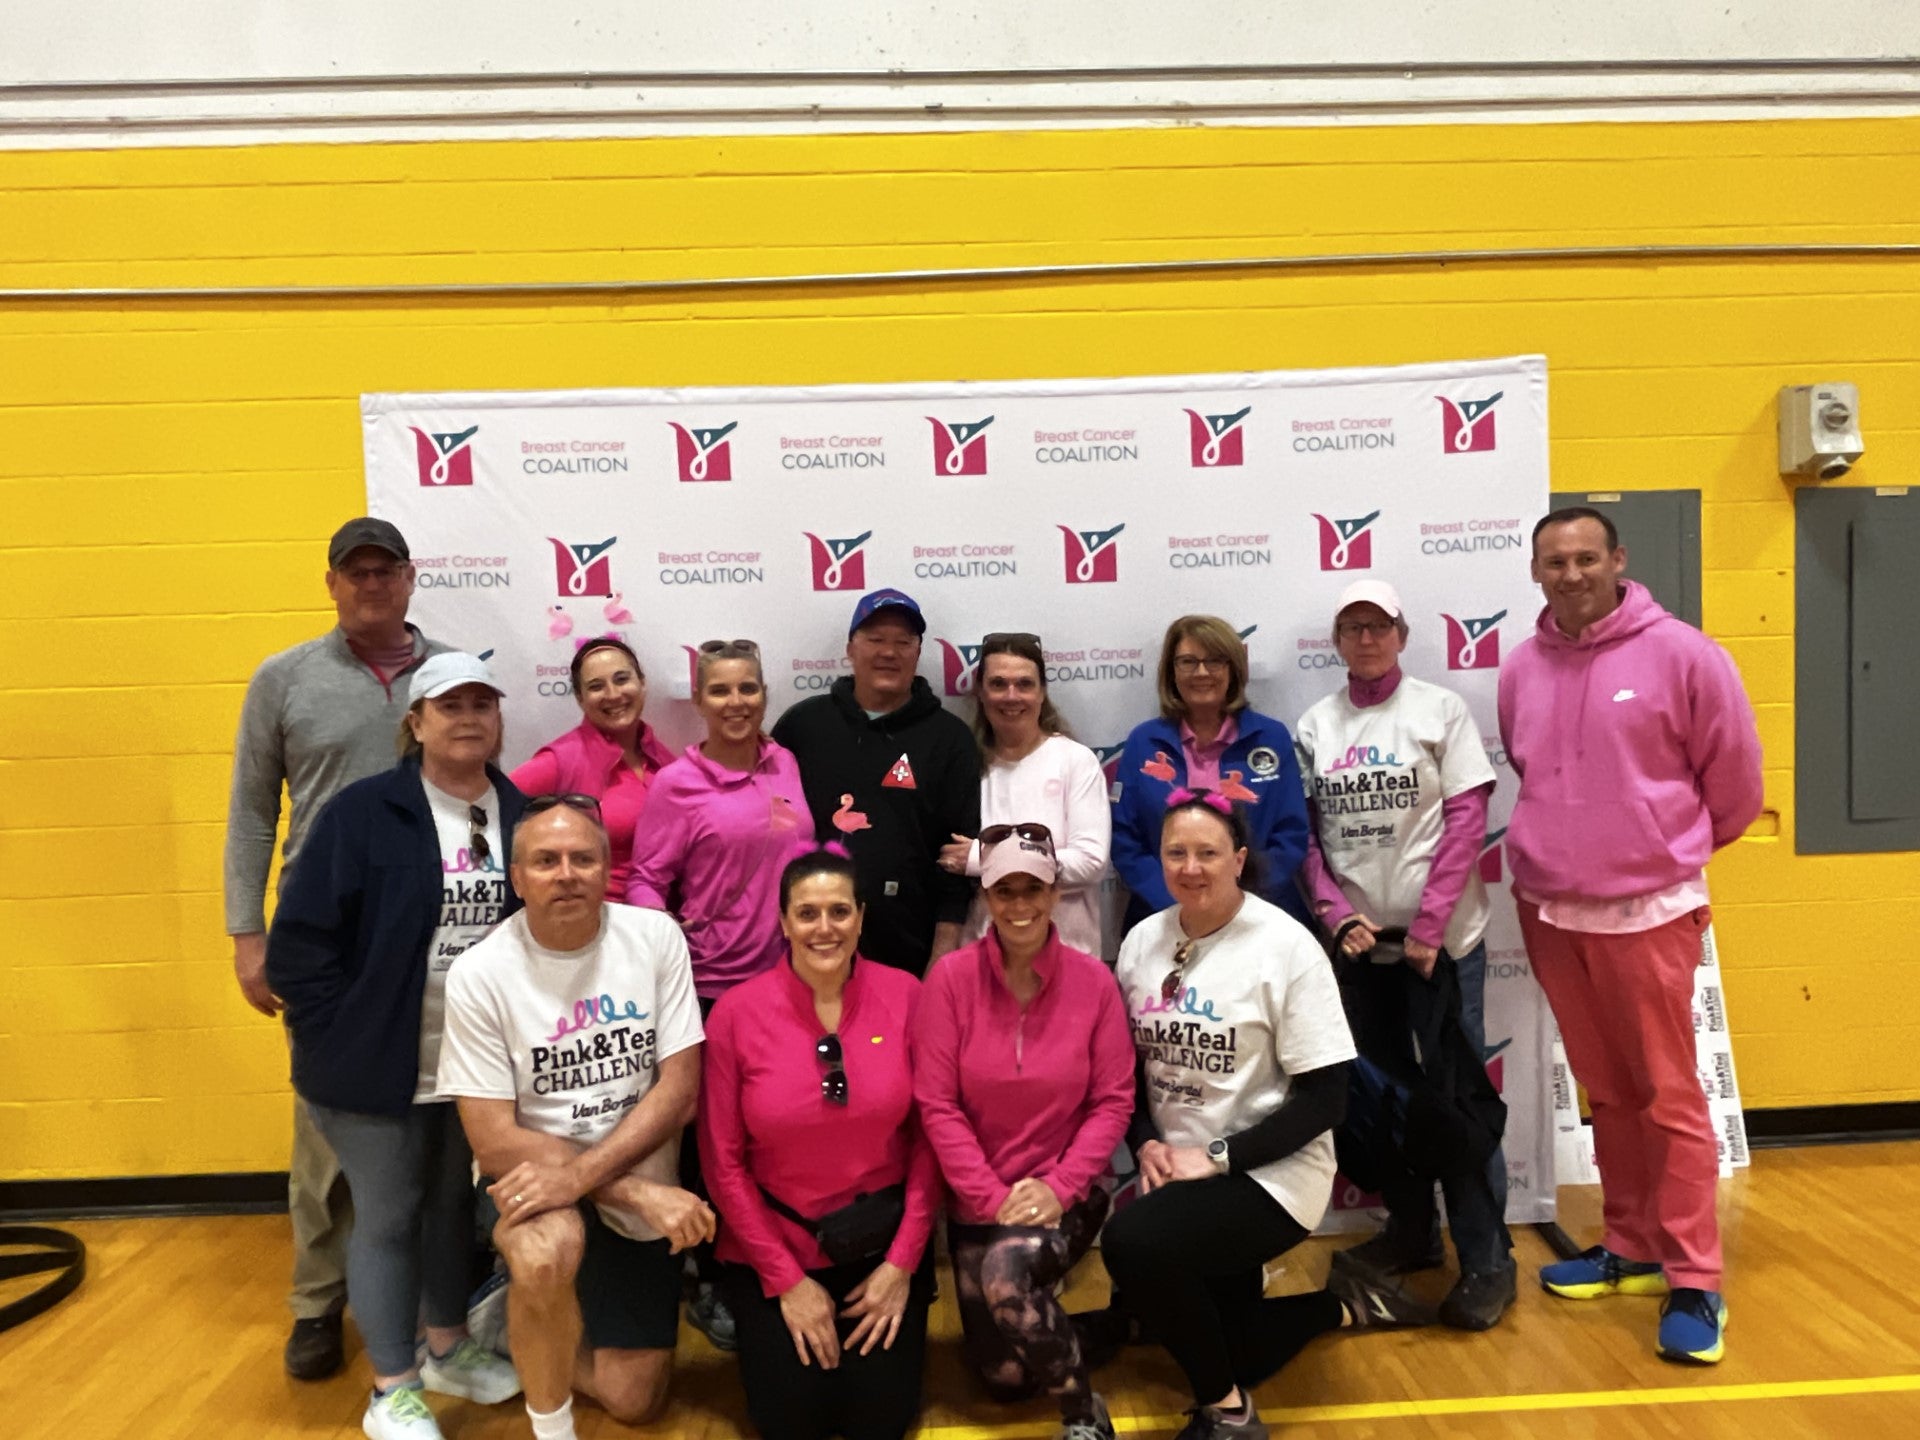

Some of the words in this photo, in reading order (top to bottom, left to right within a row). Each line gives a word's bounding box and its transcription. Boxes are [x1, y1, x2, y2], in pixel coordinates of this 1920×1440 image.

[1292, 420, 1336, 432] Breast
[1340, 417, 1393, 430] Cancer
[780, 437, 826, 449] Breast
[829, 435, 883, 448] Cancer
[1034, 430, 1079, 443] Breast
[1082, 429, 1137, 441] Cancer
[1292, 433, 1395, 452] COALITION
[521, 441, 566, 453] Breast
[570, 441, 625, 452] Cancer
[1035, 446, 1138, 463] COALITION
[522, 457, 628, 474] COALITION
[782, 451, 885, 469] COALITION
[1420, 522, 1464, 535] Breast
[1468, 518, 1521, 531] Cancer
[1168, 536, 1212, 548] Breast
[1216, 533, 1269, 547] Cancer
[1421, 534, 1522, 555] COALITION
[658, 551, 703, 564] Breast
[706, 550, 762, 563] Cancer
[912, 545, 957, 558] Breast
[961, 544, 1014, 556] Cancer
[1169, 549, 1271, 569] COALITION
[411, 556, 448, 568] reast
[451, 555, 508, 568] Cancer
[914, 560, 1017, 578] COALITION
[417, 571, 510, 588] OALITION
[660, 567, 763, 584] COALITION
[1297, 638, 1331, 650] Brea
[1089, 648, 1143, 661] Cancer
[536, 664, 570, 676] Brea
[792, 658, 836, 670] Breast
[1314, 767, 1419, 796] Pink&Teal
[1319, 790, 1420, 815] CHALLENGE
[531, 1027, 656, 1073] Pink&Tea
[533, 1050, 655, 1095] CHALLENG
[572, 1104, 600, 1119] Van
